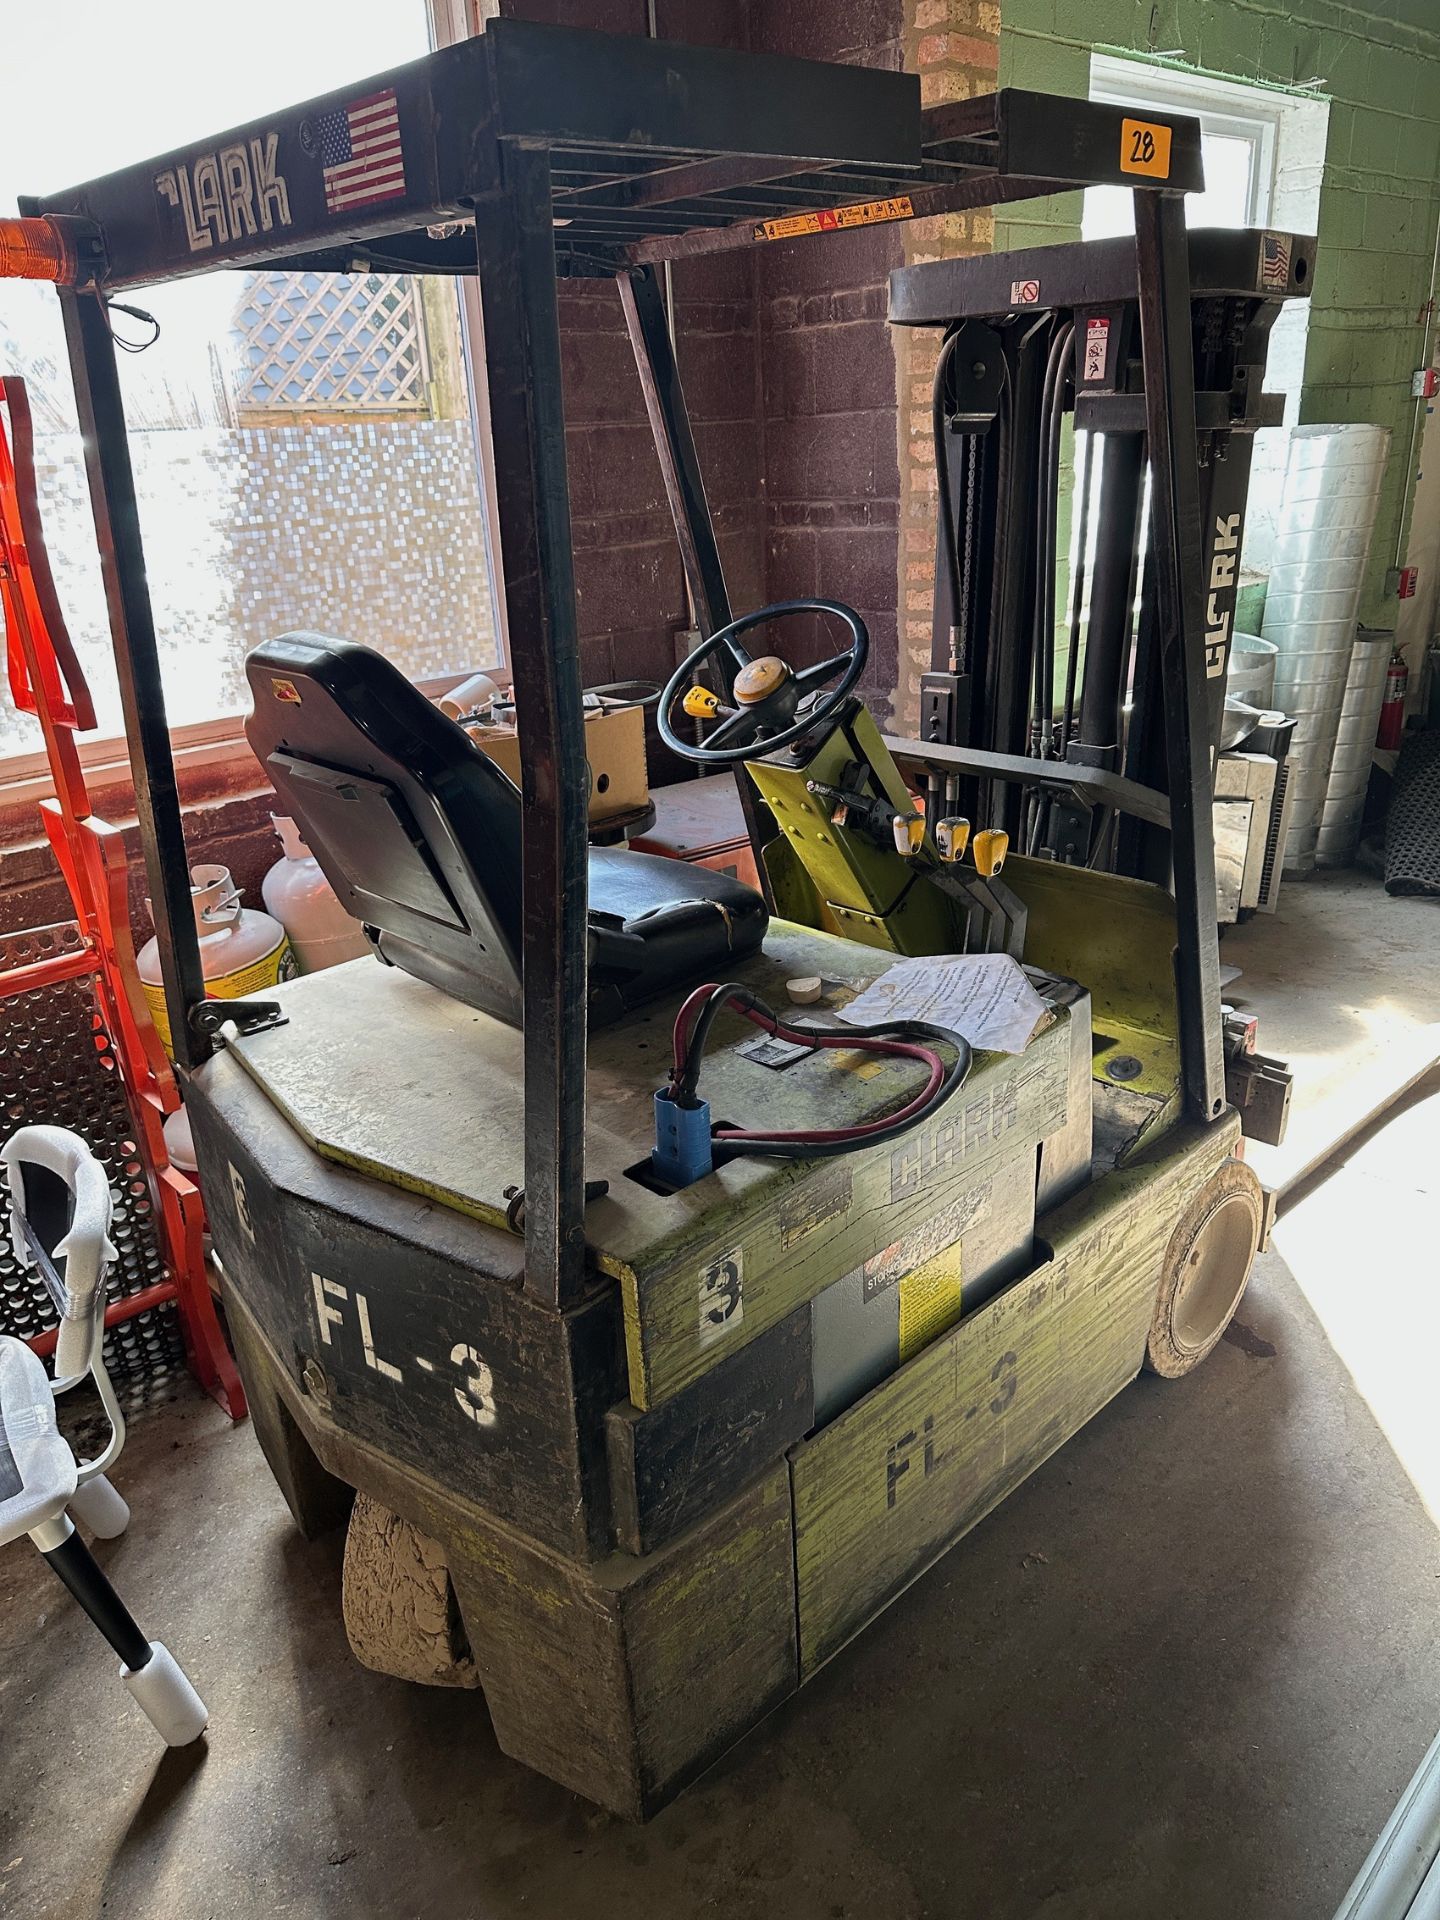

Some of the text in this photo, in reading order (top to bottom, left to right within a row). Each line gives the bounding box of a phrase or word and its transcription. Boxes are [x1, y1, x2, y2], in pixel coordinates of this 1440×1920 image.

[1130, 130, 1155, 163] 28
[891, 1083, 1018, 1204] CLARK
[707, 1261, 740, 1324] 3
[311, 1272, 496, 1426] FL-3
